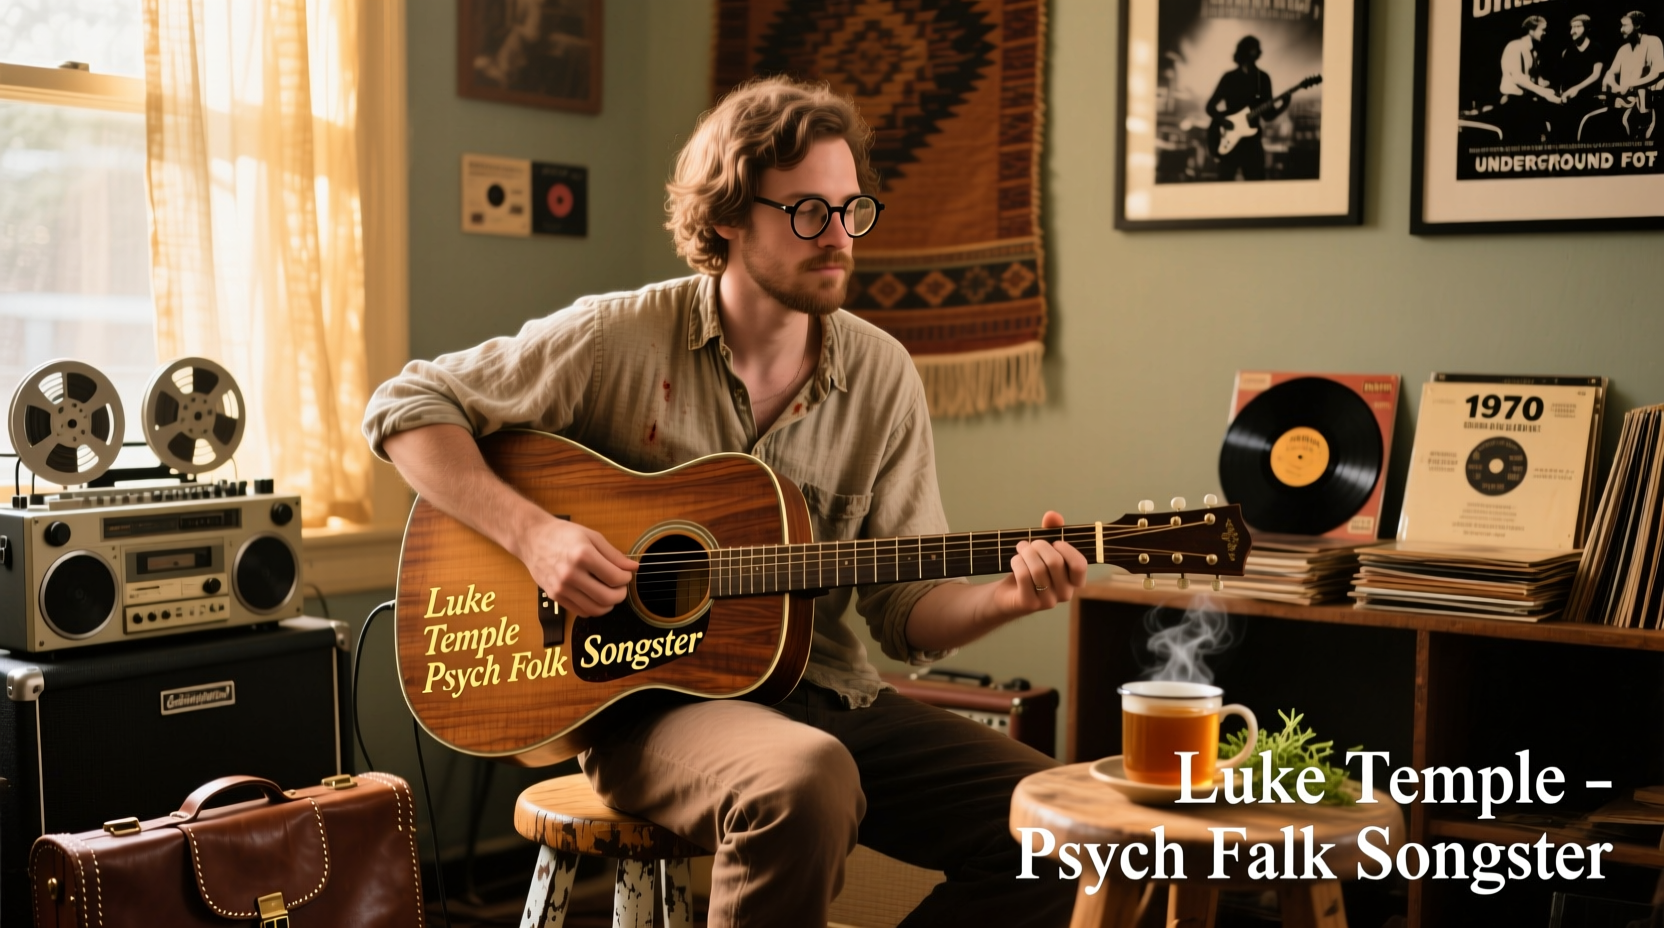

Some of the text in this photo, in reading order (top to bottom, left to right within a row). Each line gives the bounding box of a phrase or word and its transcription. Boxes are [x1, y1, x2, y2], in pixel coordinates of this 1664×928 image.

[1475, 152, 1614, 173] UNDERGROUND
[1465, 394, 1545, 422] 1970
[423, 583, 497, 619] Luke
[423, 616, 521, 659] Temple
[422, 629, 705, 699] Psych Folk Songster
